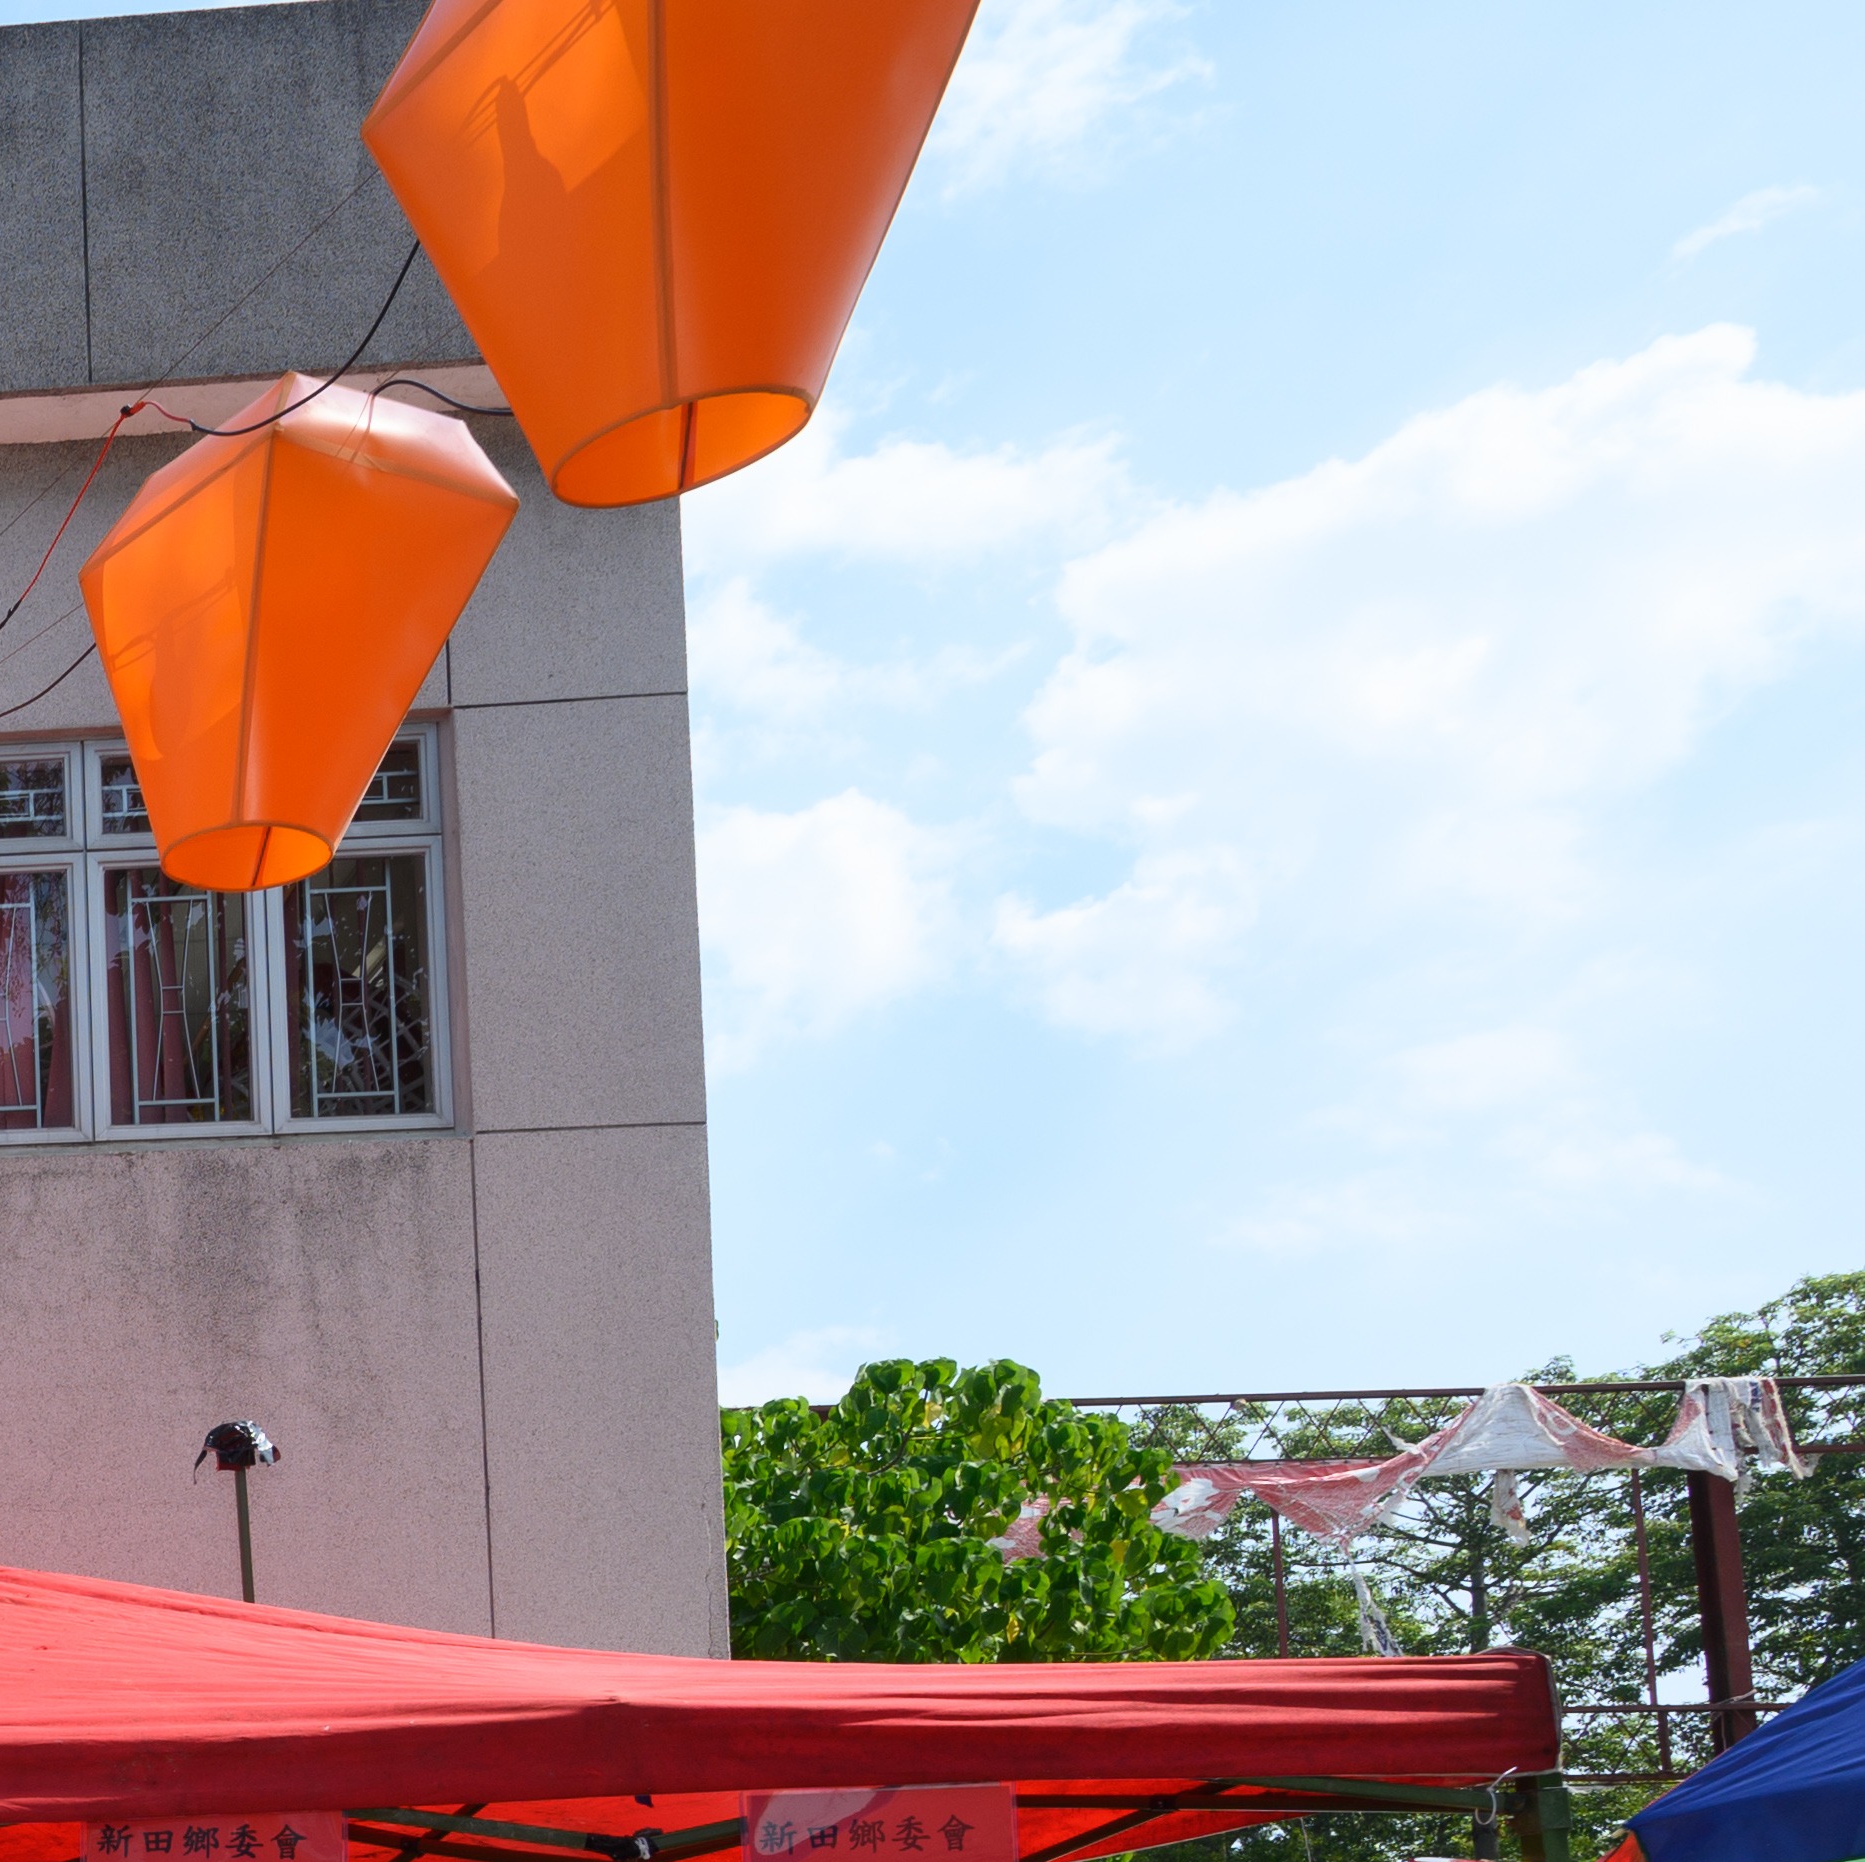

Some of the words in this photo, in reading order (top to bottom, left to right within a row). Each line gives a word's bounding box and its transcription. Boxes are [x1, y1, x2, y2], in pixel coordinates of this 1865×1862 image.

[96, 1822, 307, 1862] 新田鄉委會
[759, 1813, 973, 1856] 新田鄉委會
